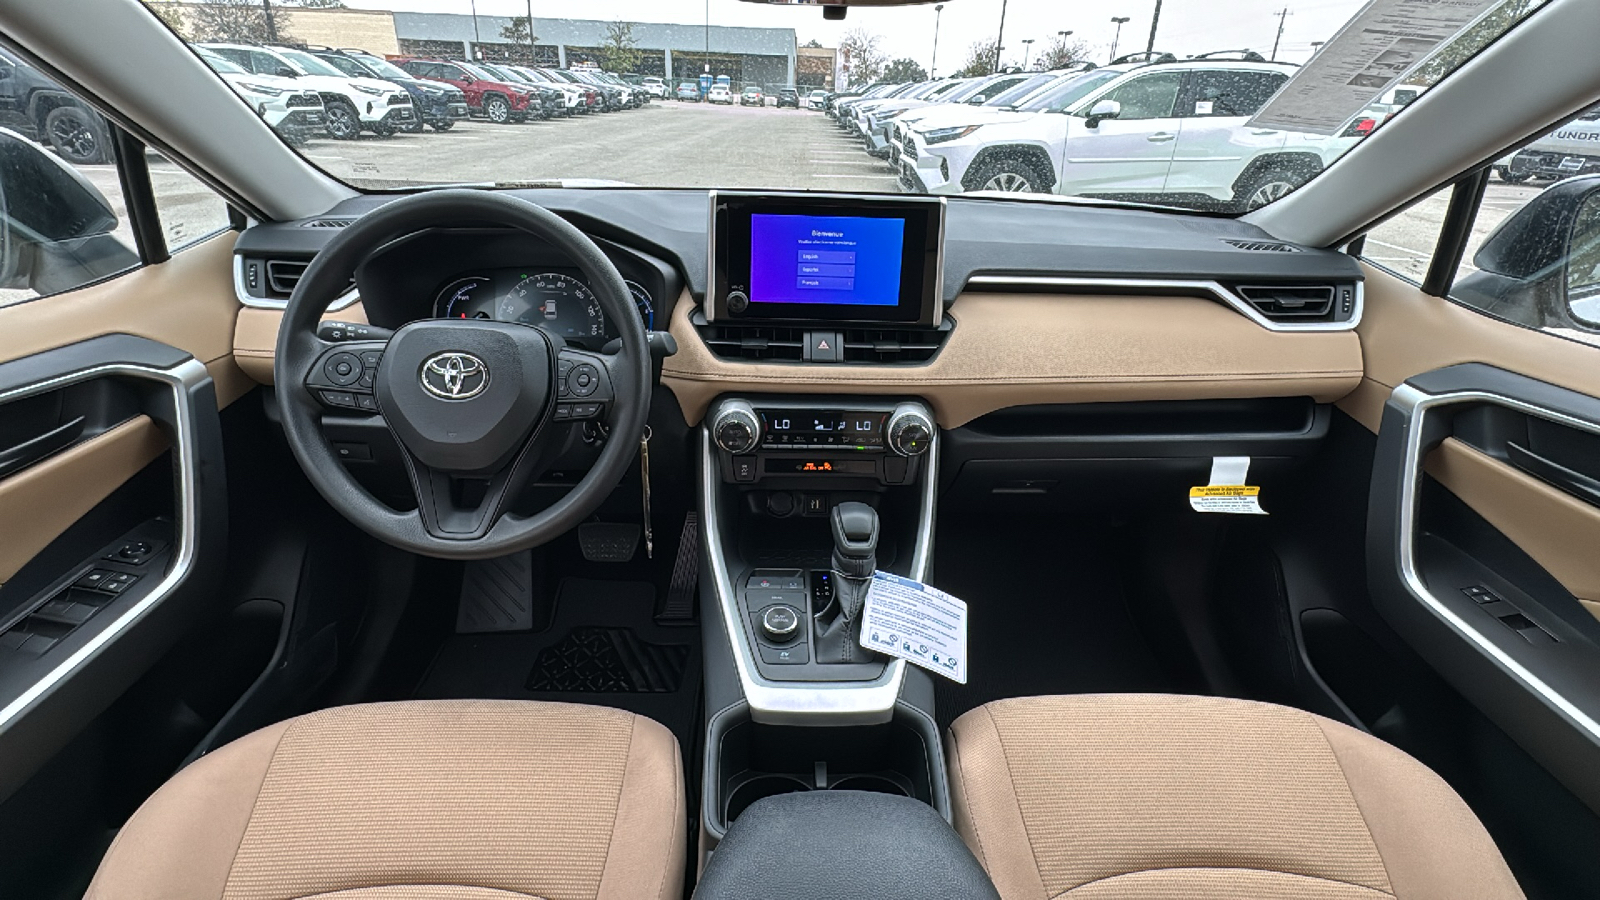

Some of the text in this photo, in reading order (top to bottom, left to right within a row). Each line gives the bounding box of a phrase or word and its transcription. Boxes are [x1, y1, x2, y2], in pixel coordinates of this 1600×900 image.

[811, 229, 844, 238] Bienvenue
[556, 281, 566, 289] 80
[574, 289, 585, 300] 100
[774, 419, 791, 429] LO
[856, 420, 871, 431] LO
